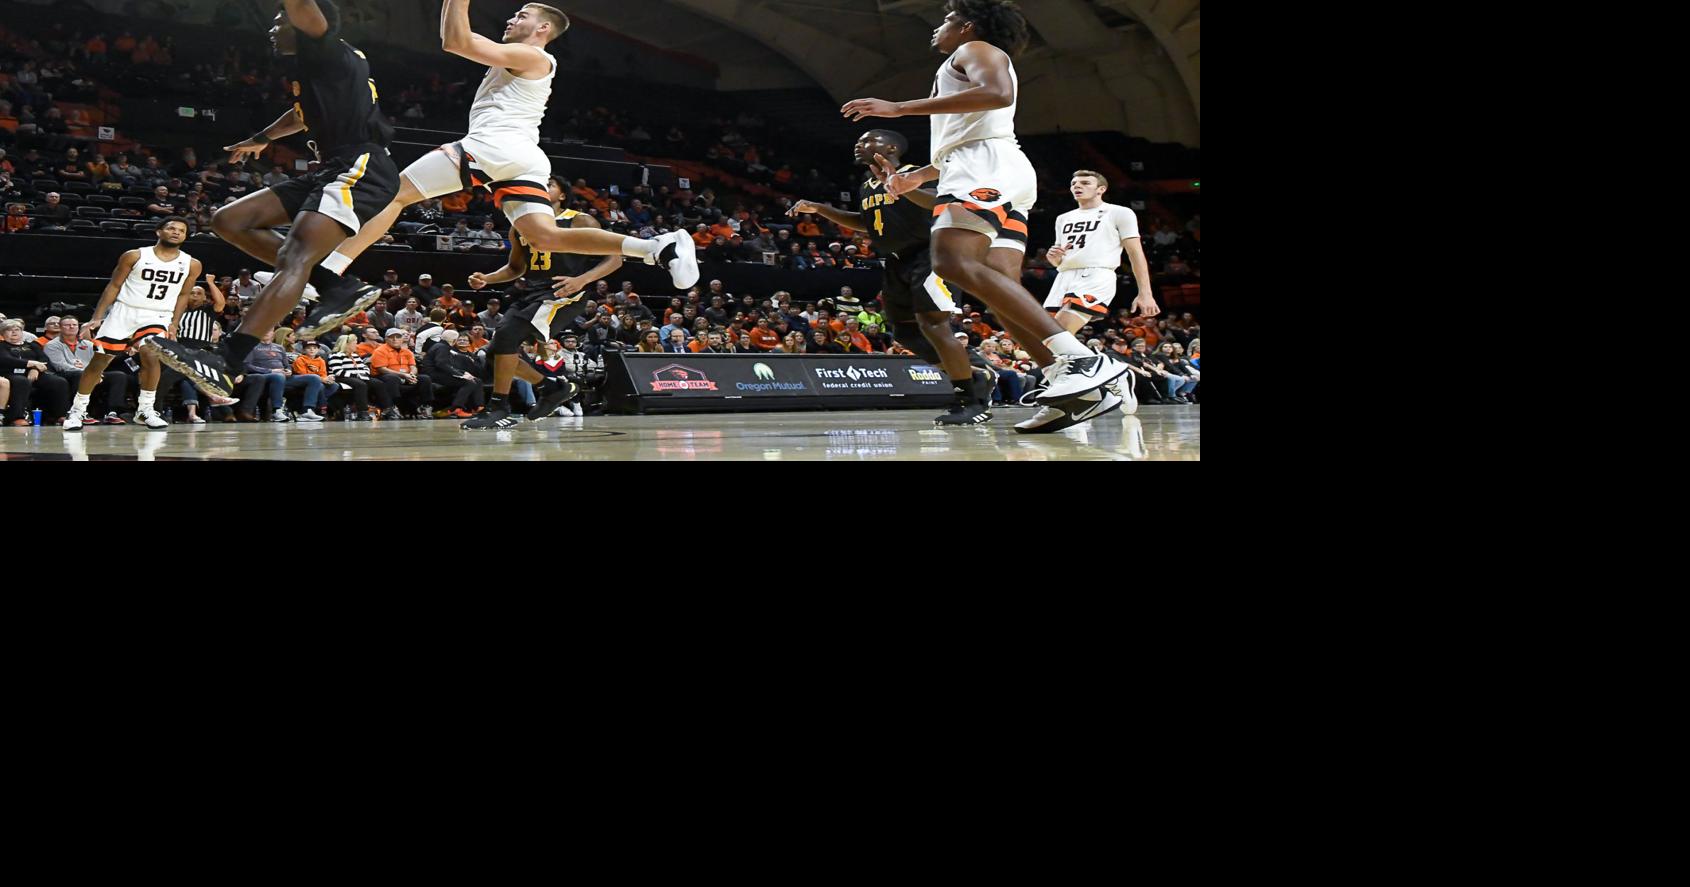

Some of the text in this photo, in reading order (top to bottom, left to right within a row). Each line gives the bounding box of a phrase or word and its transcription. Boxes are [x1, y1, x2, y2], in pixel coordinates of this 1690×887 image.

[874, 208, 884, 236] 4
[1062, 220, 1100, 234] OSU
[1066, 234, 1086, 249] 24
[530, 250, 551, 270] 23
[141, 268, 184, 284] OSU
[146, 283, 168, 300] 13
[815, 367, 888, 378] First Tech
[908, 369, 942, 380] Rodda
[736, 382, 772, 392] Oregon
